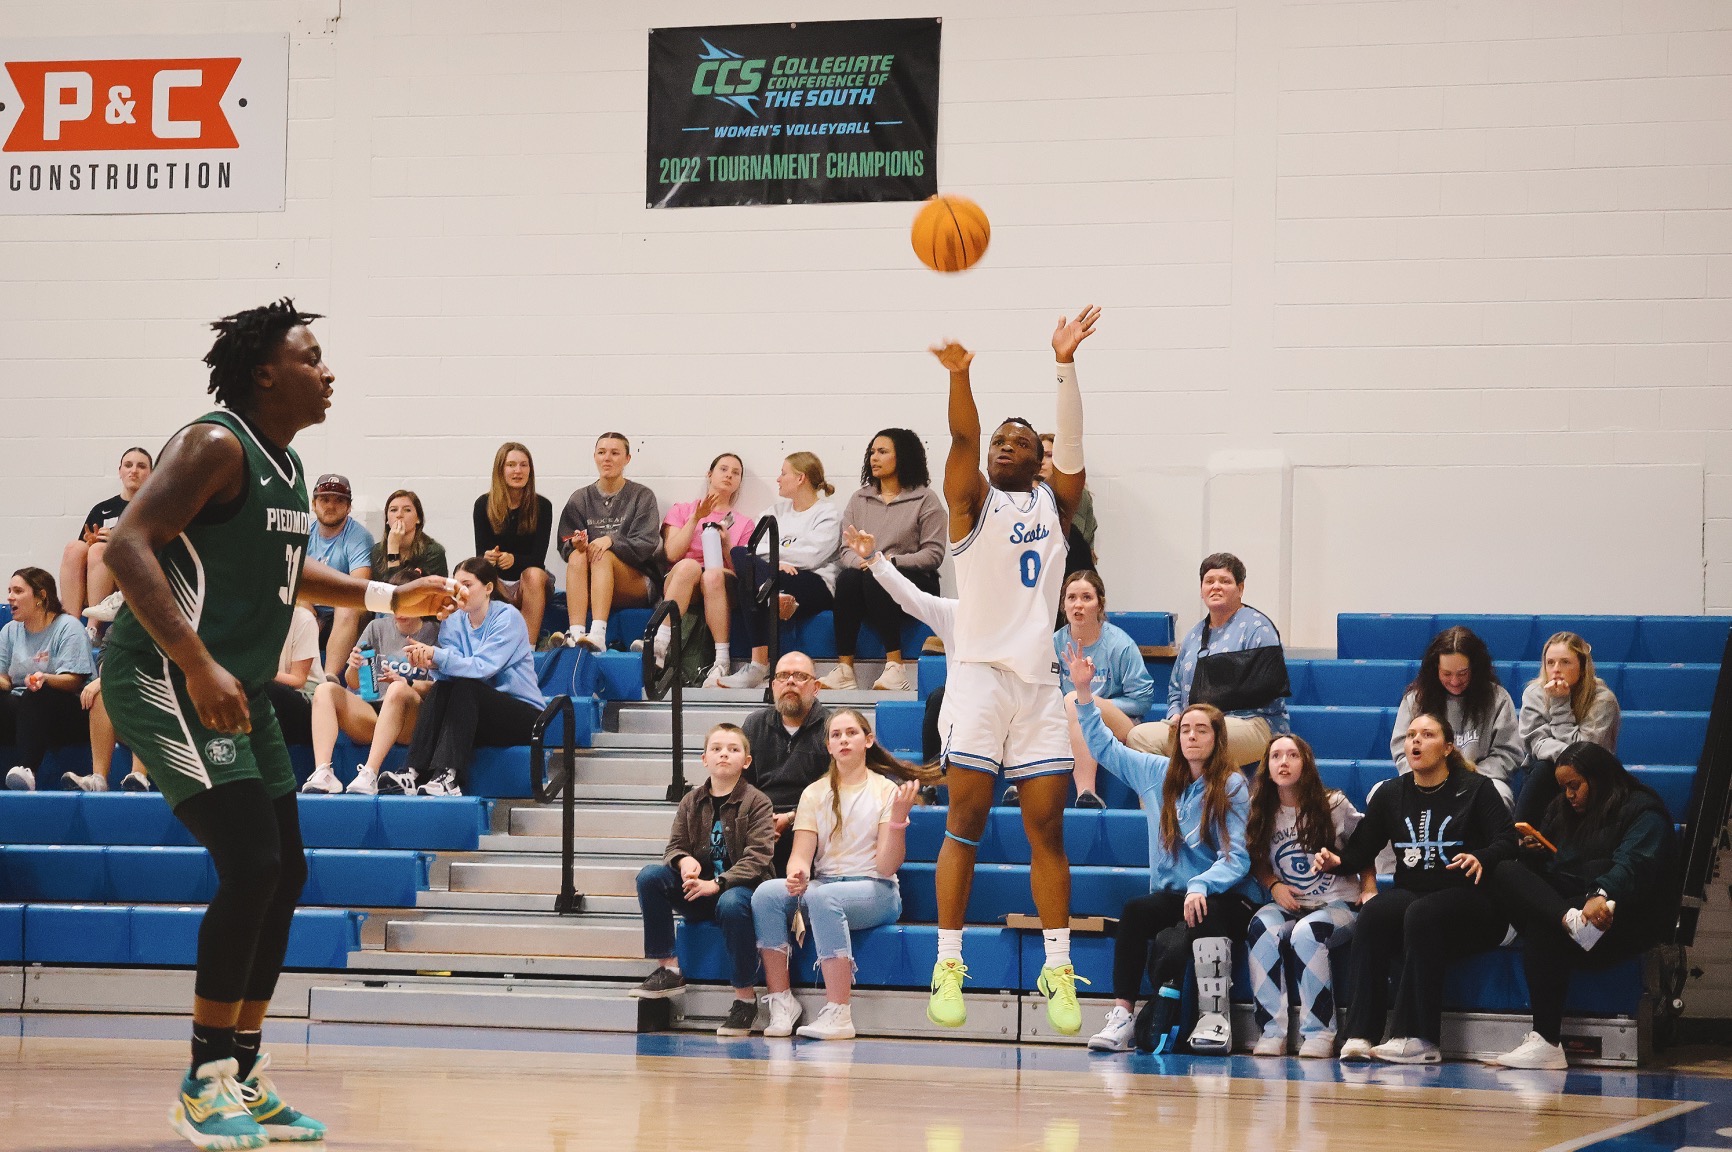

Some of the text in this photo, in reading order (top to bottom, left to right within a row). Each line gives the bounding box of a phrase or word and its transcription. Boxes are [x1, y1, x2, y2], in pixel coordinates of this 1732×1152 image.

[771, 55, 895, 75] COLLEGIATE
[692, 59, 767, 96] CCS
[767, 73, 889, 90] CONFERENCE OF
[764, 88, 876, 108] THE SOUTH
[714, 122, 870, 138] WOMEN'S VOLLEYBALL
[9, 162, 232, 191] CONSTRUCTION
[659, 150, 924, 184] 2022 TOURNAMENT CHAMPIONS
[1009, 522, 1050, 544] Scots
[1020, 549, 1041, 588] 0
